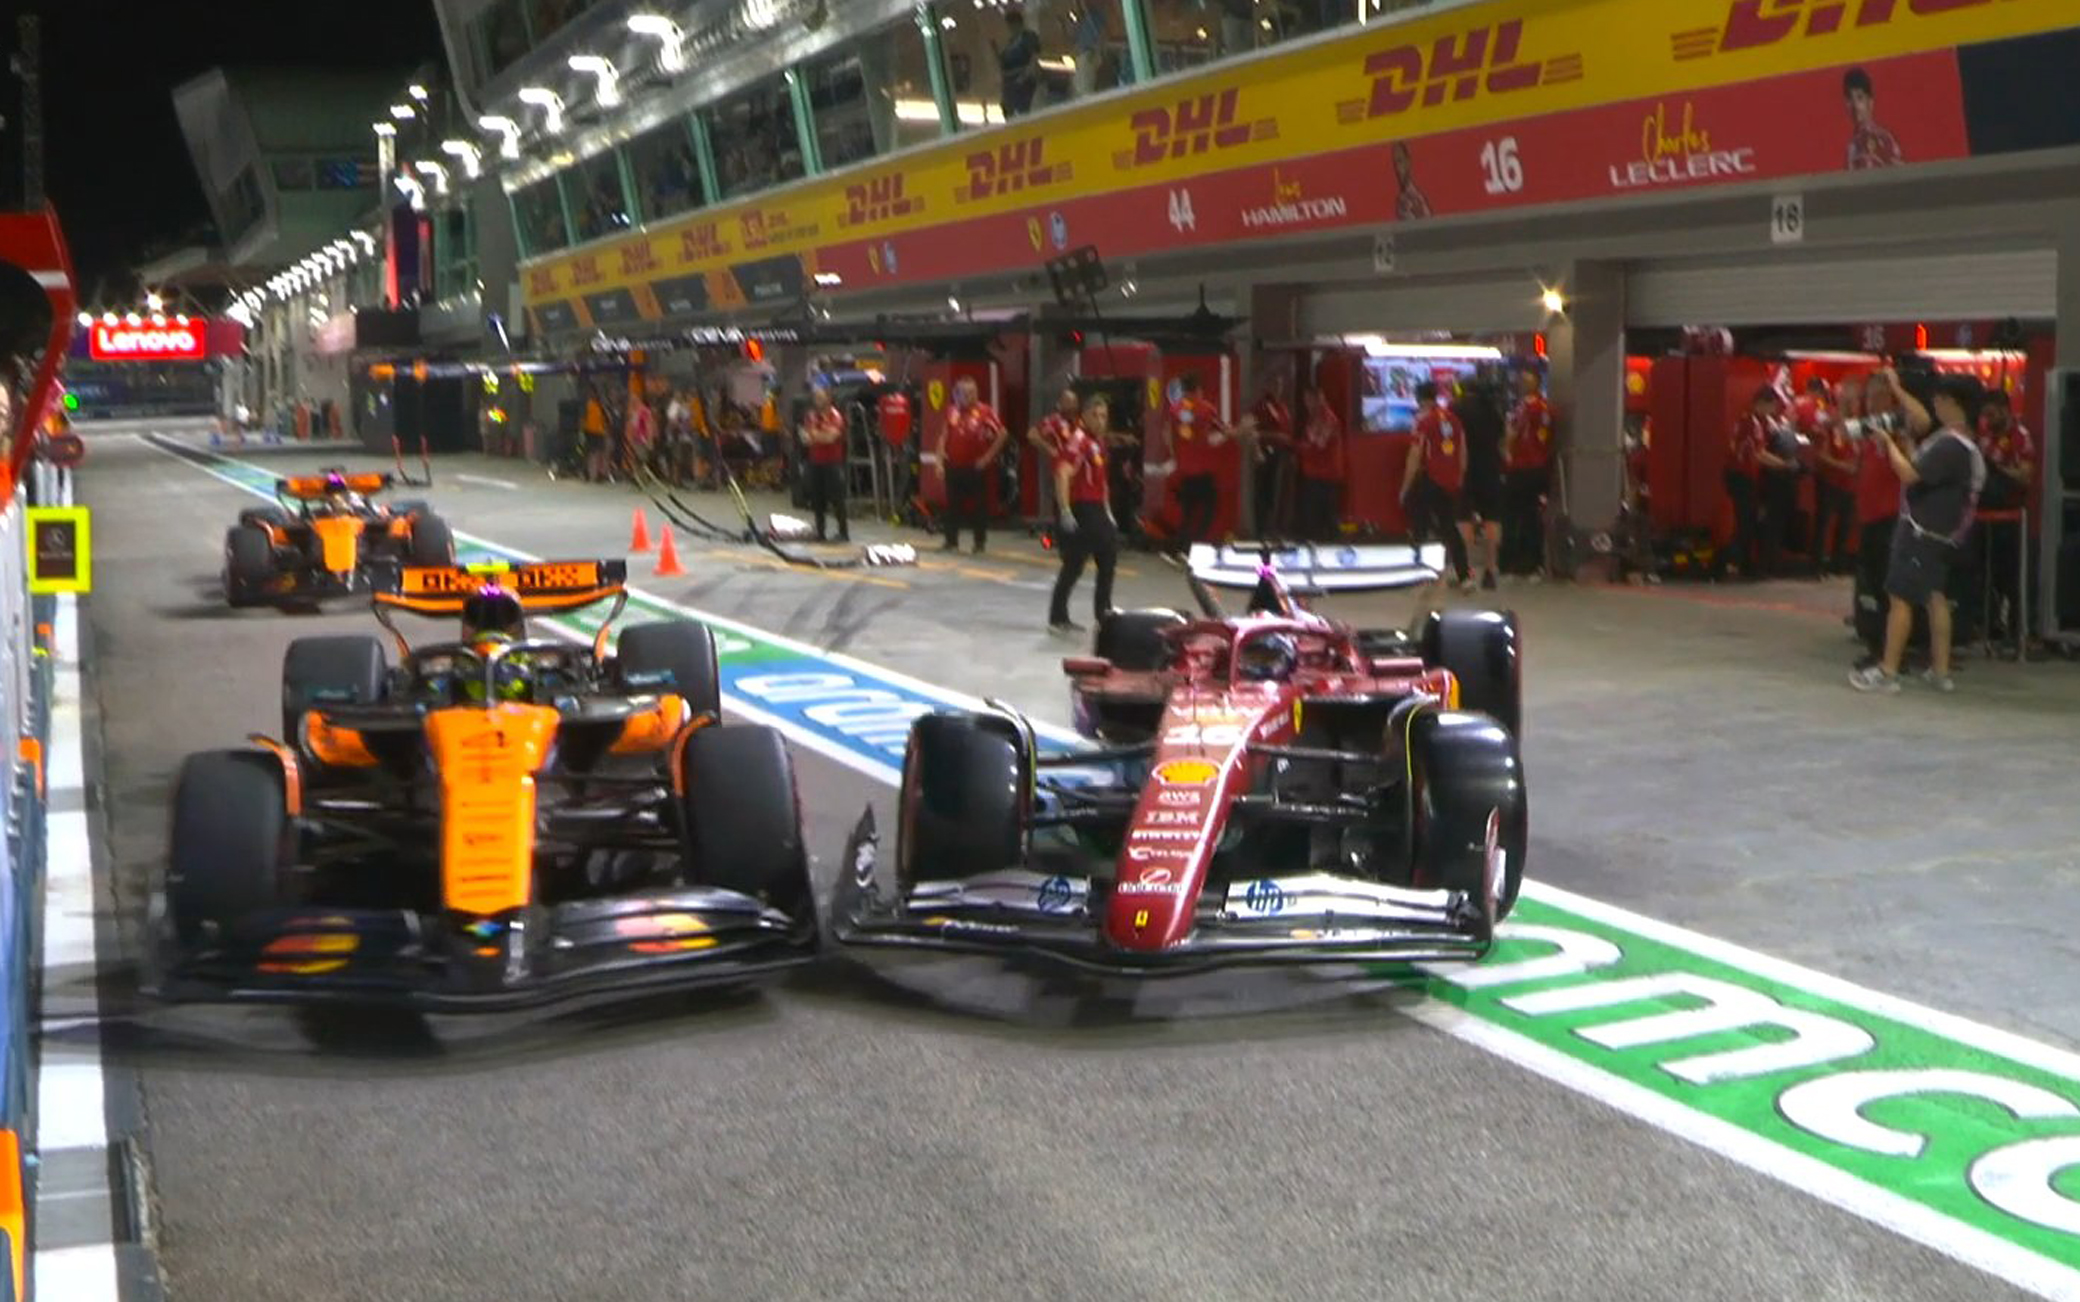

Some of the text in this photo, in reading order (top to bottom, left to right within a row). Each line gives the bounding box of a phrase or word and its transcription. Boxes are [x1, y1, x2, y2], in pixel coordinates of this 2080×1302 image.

[1363, 17, 1543, 120] DHL
[1130, 88, 1251, 167] DHL
[965, 136, 1053, 200] DHL
[1481, 136, 1523, 194] 16
[1609, 147, 1756, 187] LECLERC
[846, 172, 912, 226] DHL
[1168, 188, 1195, 233] 44
[1242, 197, 1347, 227] HAMILTON
[97, 326, 195, 352] Lenovo
[1247, 879, 1283, 916] hp
